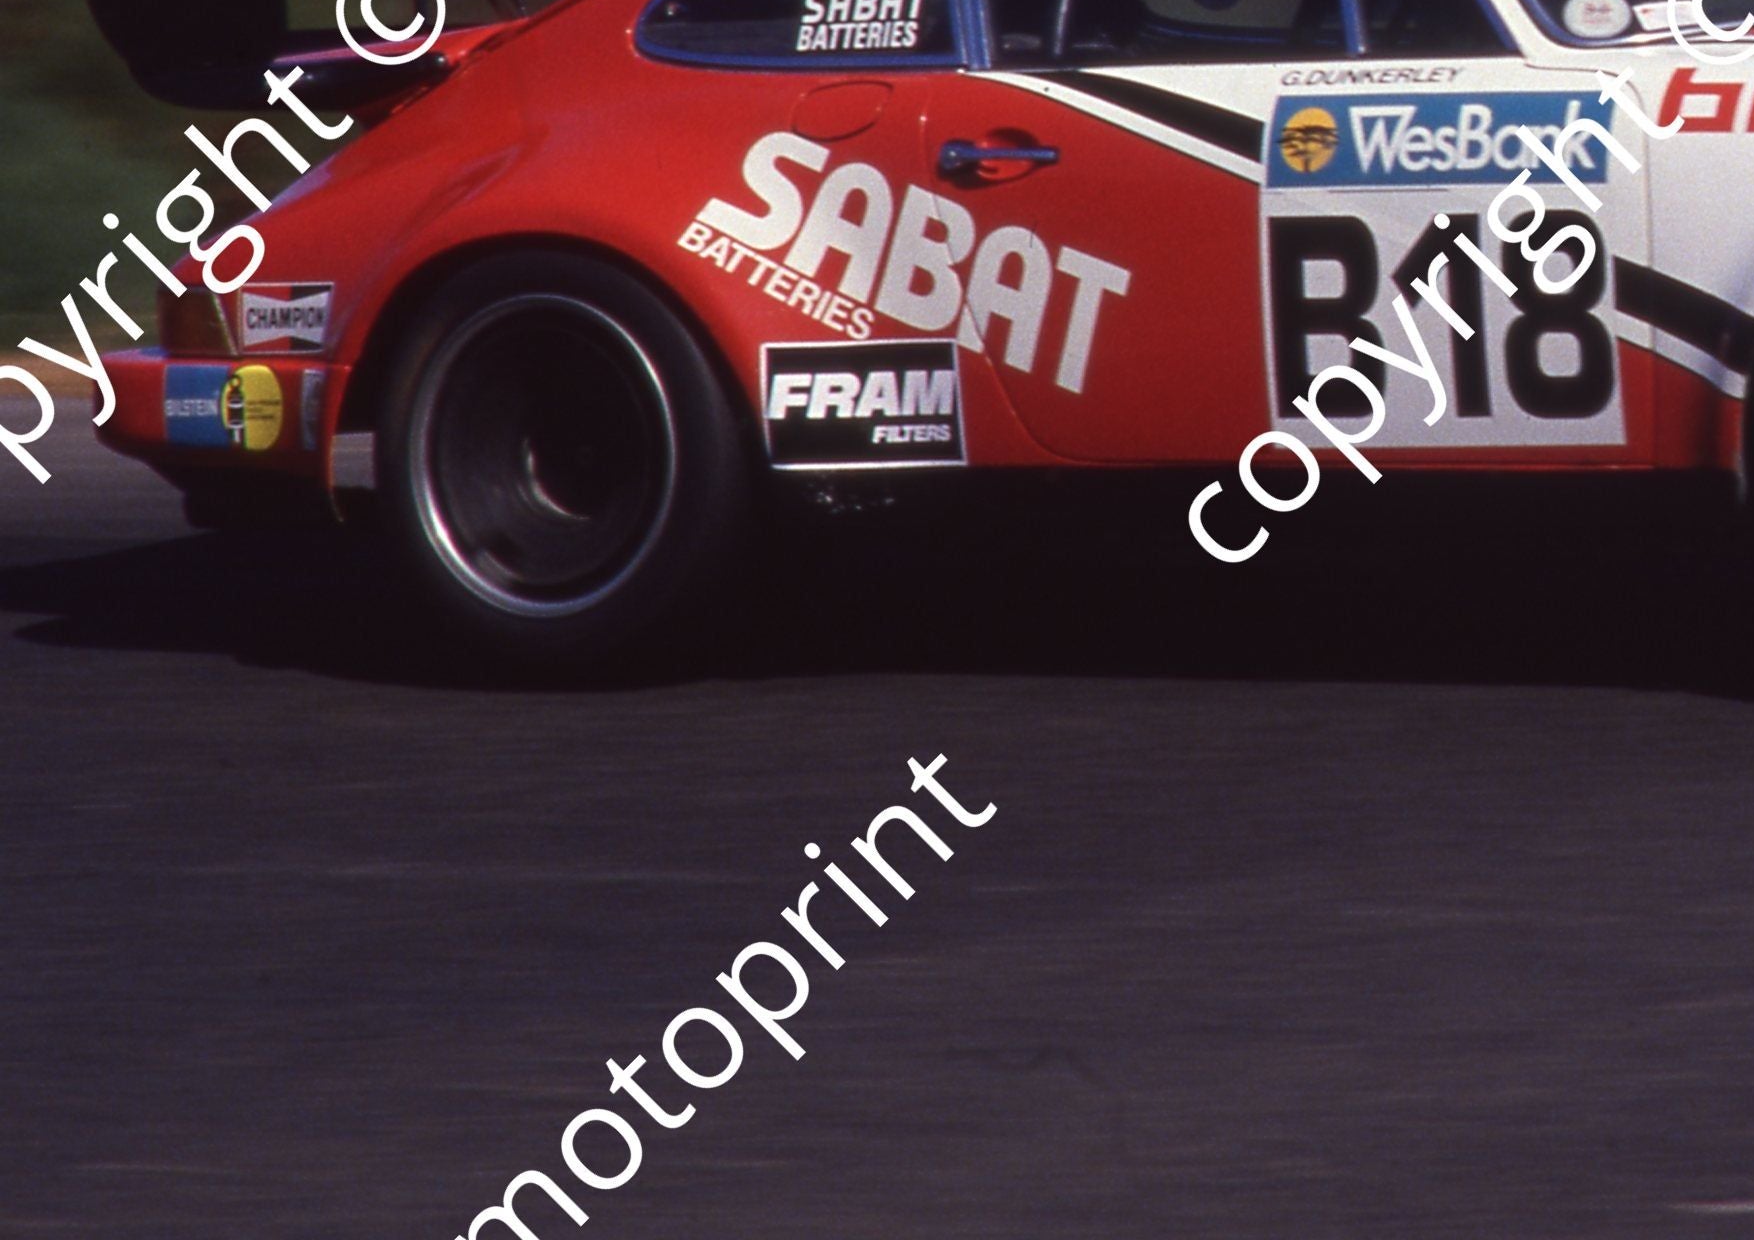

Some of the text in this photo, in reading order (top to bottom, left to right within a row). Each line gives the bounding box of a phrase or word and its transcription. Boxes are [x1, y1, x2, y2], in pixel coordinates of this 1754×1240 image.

[796, 20, 918, 52] BATTERIES
[1349, 100, 1596, 173] WesBank
[676, 222, 875, 341] BATTERIES
[696, 131, 1132, 395] SABAT
[247, 306, 324, 329] CHAMPION
[1269, 210, 1615, 418] B18
[766, 369, 953, 420] FRAM
[871, 424, 951, 444] FILTERS
